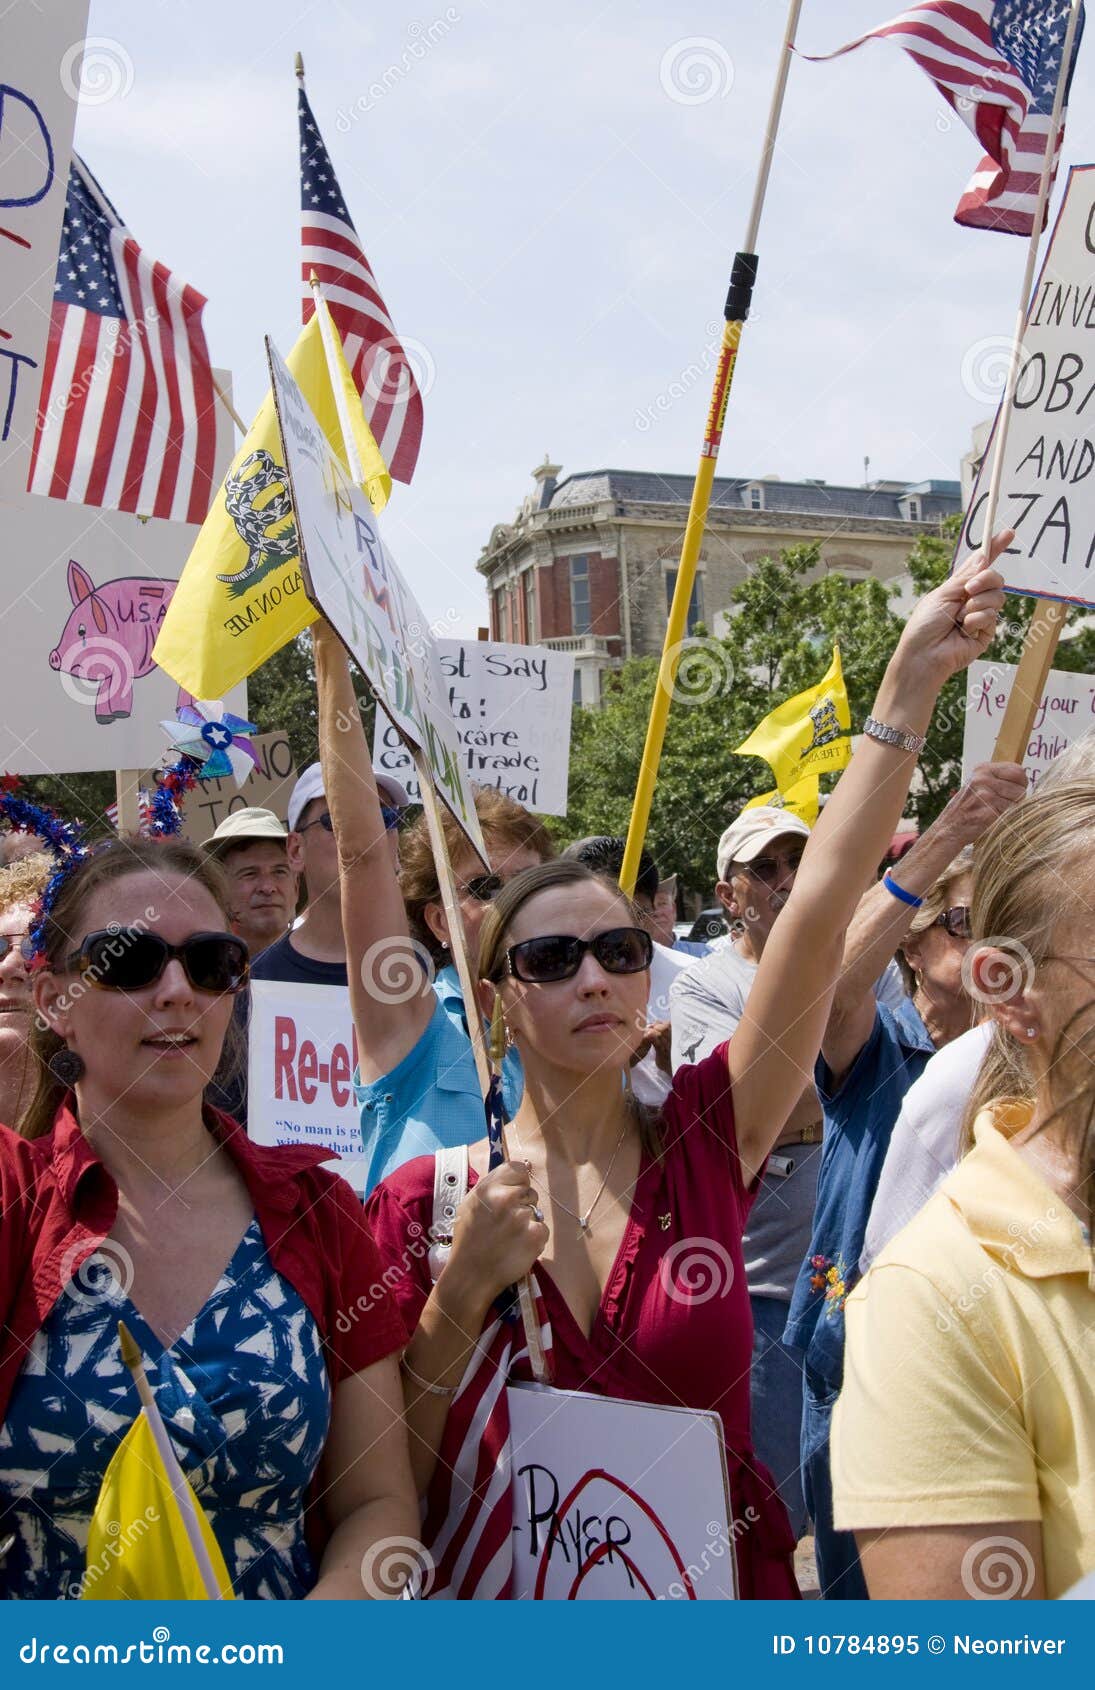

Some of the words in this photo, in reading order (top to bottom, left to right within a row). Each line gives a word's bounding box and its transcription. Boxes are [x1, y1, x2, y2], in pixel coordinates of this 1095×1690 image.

[1015, 435, 1095, 484] AND
[966, 488, 1095, 568] CZA
[440, 647, 471, 678] st
[483, 654, 547, 691] Say
[977, 677, 1006, 717] Ke
[1032, 696, 1079, 730] your
[305, 1125, 332, 1136] man
[336, 1125, 346, 1136] is
[329, 1141, 353, 1153] that
